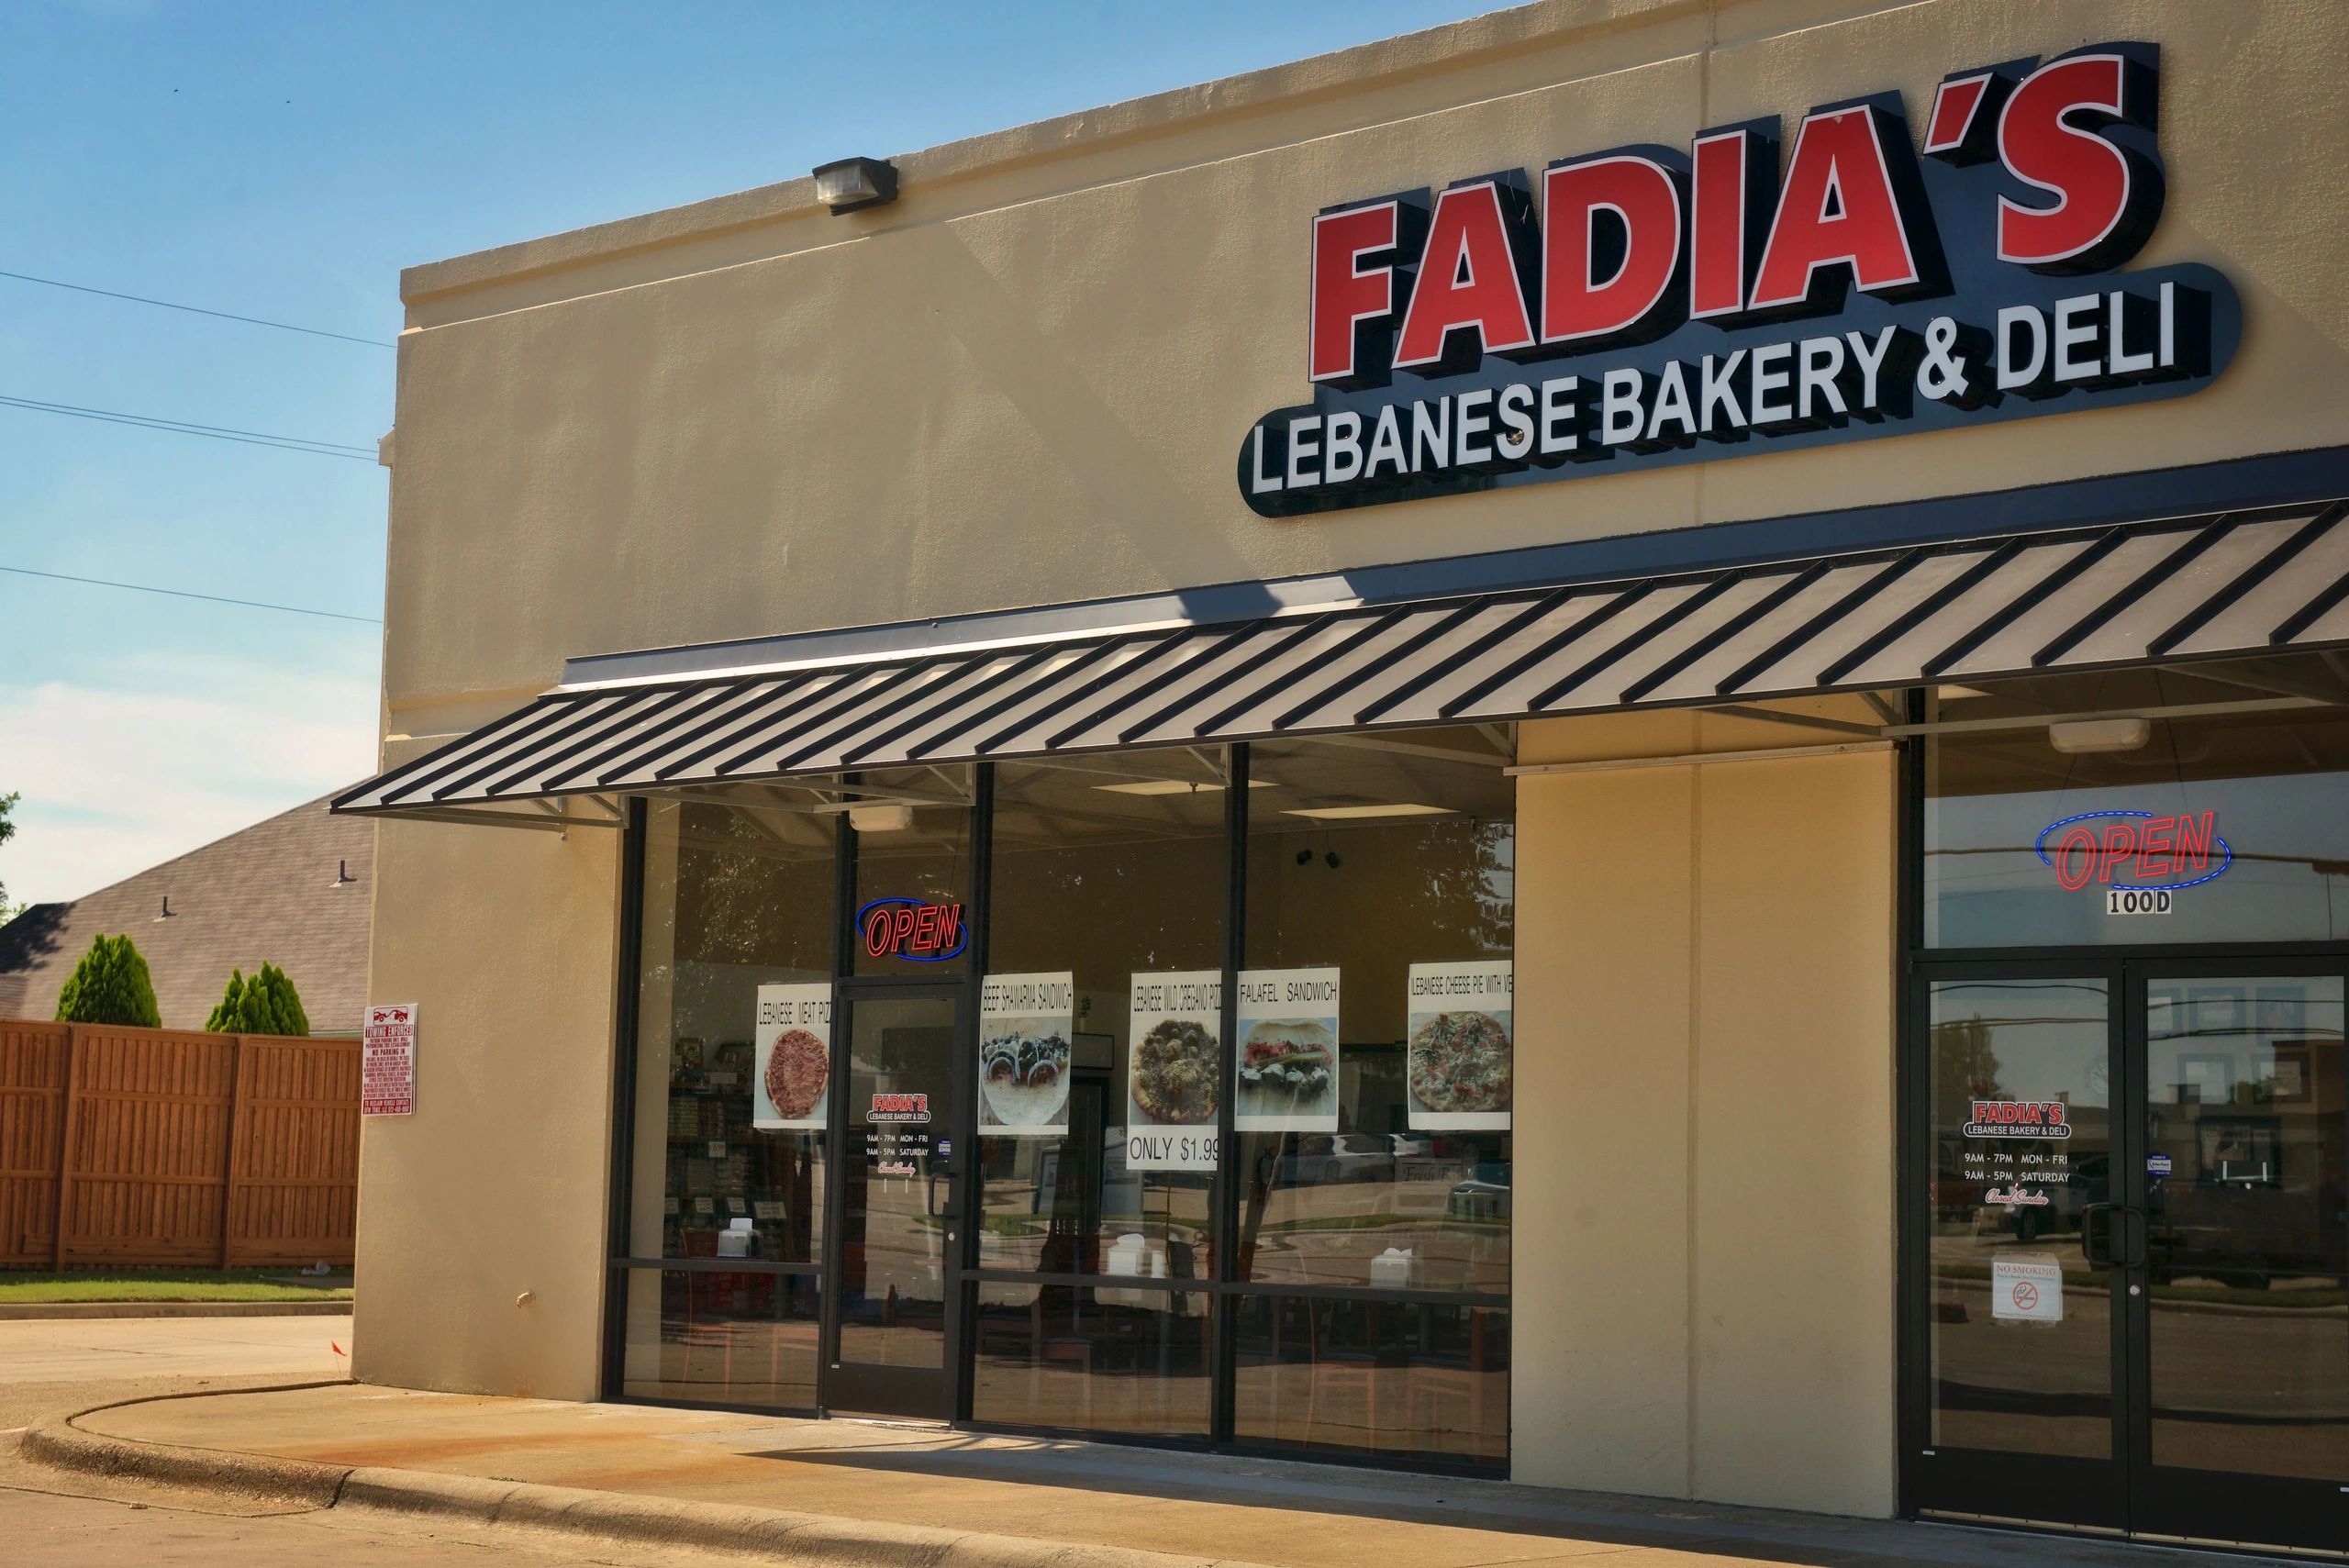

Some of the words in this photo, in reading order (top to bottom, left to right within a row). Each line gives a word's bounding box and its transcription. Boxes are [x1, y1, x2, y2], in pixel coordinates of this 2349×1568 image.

[1308, 52, 2133, 384] FADIA'S
[1252, 377, 1578, 495] LEBANESE
[1601, 324, 1901, 444] BAKERY
[1916, 317, 1971, 402] &
[1997, 281, 2176, 392] DELI
[2055, 809, 2214, 891] OPEN
[2110, 890, 2170, 914] 100D
[866, 903, 961, 958] OPEN
[1240, 983, 1279, 1003] FALAFEL
[1286, 981, 1337, 1002] SANDWICH
[1411, 976, 1443, 995] LEBANESE
[1445, 975, 1471, 995] CHEESE
[1473, 974, 1484, 995] PIE
[1486, 974, 1501, 995] WITH
[1503, 973, 1512, 994] VE
[984, 985, 1000, 1011] BEEF
[1002, 984, 1036, 1011] SHAWARMA
[1038, 982, 1072, 1010] SANDWICH
[1133, 985, 1162, 1012] LEBANESE
[1163, 984, 1177, 1011] WILD
[1209, 984, 1221, 1010] PIZZ
[759, 1002, 793, 1025] LEBANESE
[797, 1001, 816, 1024] MEAT
[372, 1049, 379, 1057] NO
[380, 1048, 399, 1056] PARKING
[873, 1095, 926, 1112] FADIA'S
[1975, 1103, 2063, 1125] FADIA'S
[866, 1134, 879, 1142] 9AM
[884, 1134, 896, 1142] 7PM
[899, 1134, 913, 1143] MON
[918, 1135, 929, 1143] FRI
[1967, 1125, 2008, 1135] LEBANESE
[2009, 1126, 2041, 1136] BAKERY
[2042, 1127, 2047, 1136] &
[2049, 1127, 2066, 1136] DELI
[866, 1148, 878, 1156] 9AM
[884, 1148, 896, 1156] 5PM
[899, 1148, 930, 1156] SATURDAY
[1130, 1137, 1174, 1161] ONLY
[1180, 1136, 1218, 1163] $1.99
[1965, 1152, 1985, 1163] 9AM
[1994, 1153, 2013, 1163] 7PM
[2021, 1154, 2043, 1164] MON
[2053, 1154, 2068, 1165] FRI
[1965, 1170, 1985, 1181] 9AM
[1994, 1171, 2013, 1182] 5PM
[2021, 1172, 2070, 1183] SATURDAY
[1985, 1188, 2015, 1205] Closed
[2014, 1189, 2049, 1206] Sunday
[1997, 1265, 2011, 1273] NO
[2012, 1266, 2056, 1276] SMOKING
